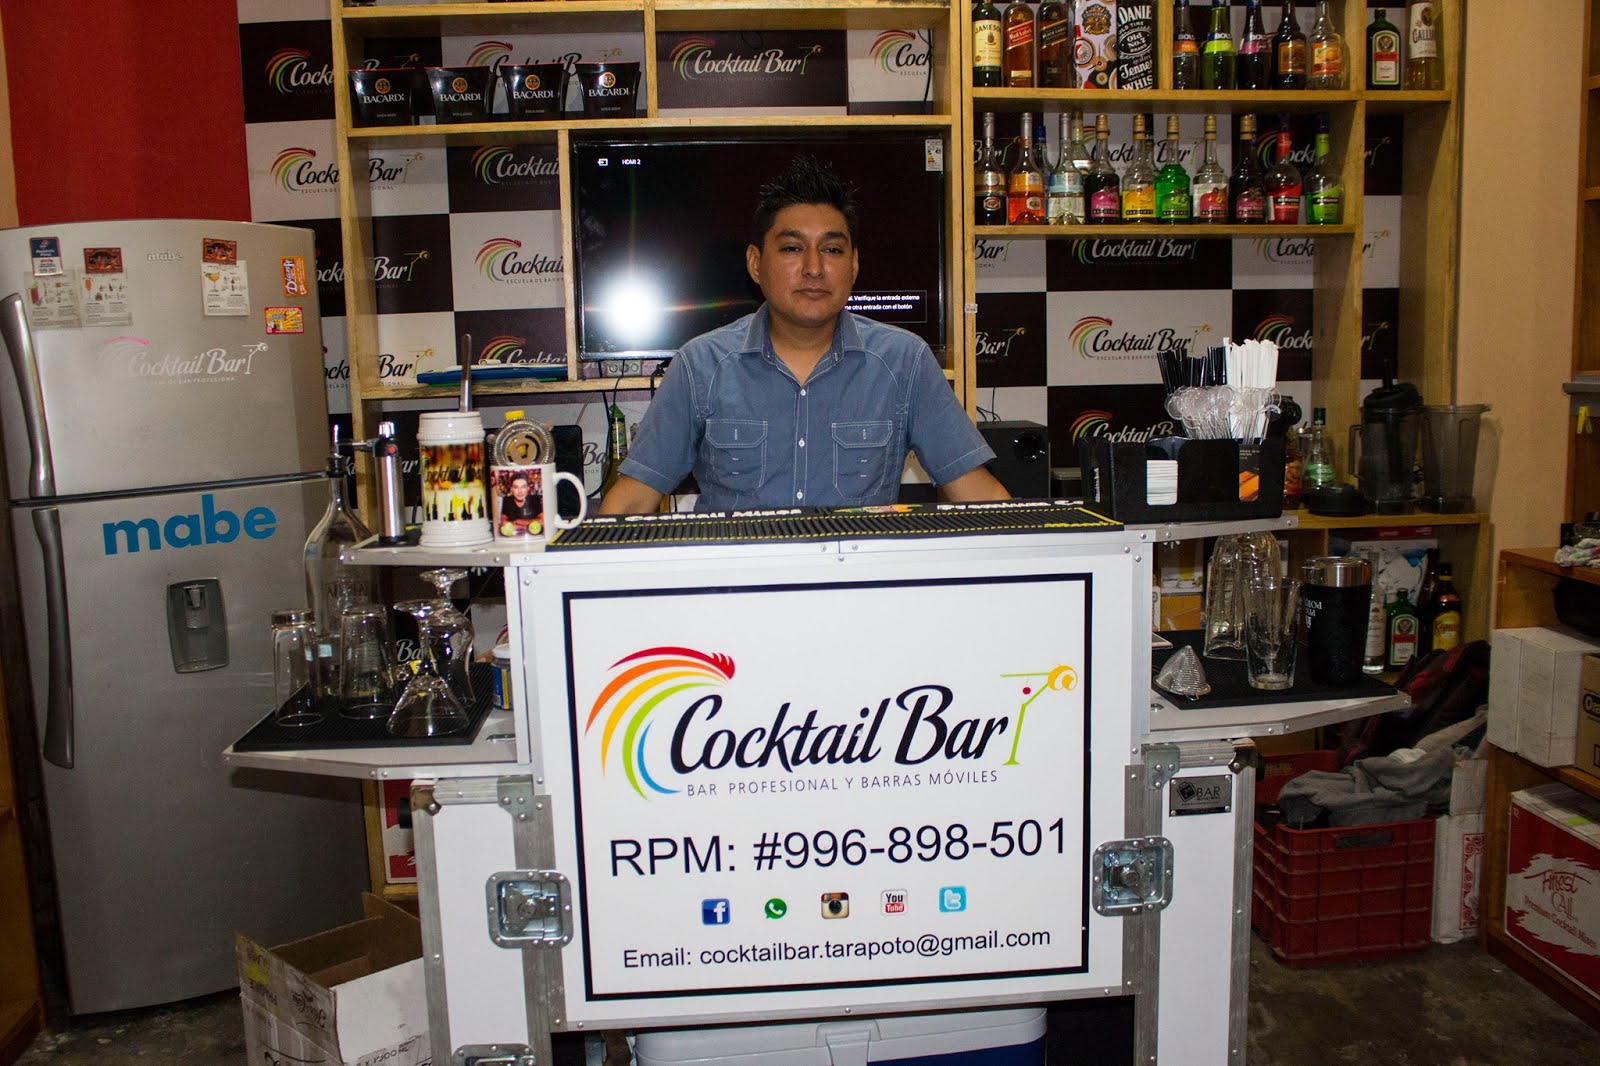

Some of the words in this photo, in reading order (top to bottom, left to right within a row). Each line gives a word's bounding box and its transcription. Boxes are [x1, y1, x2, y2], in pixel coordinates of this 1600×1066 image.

[1118, 5, 1152, 24] DANIE
[1127, 32, 1143, 42] Old
[694, 49, 765, 75] Cocktail
[764, 49, 801, 73] Bar
[1119, 60, 1152, 78] Tenne
[513, 90, 555, 99] BACARDI
[588, 88, 630, 97] BACARDI
[1122, 75, 1153, 90] WHIS
[440, 93, 482, 102] BACARDI
[369, 158, 403, 182] Bar
[147, 250, 183, 261] mabe
[1092, 239, 1157, 258] Cocktail
[1157, 239, 1192, 257] Bar
[374, 256, 408, 281] Bar
[976, 331, 1006, 356] Bar
[1093, 330, 1156, 353] Cocktail
[1157, 328, 1192, 352] Bar
[128, 352, 205, 376] Cocktail
[207, 348, 246, 374] Bar
[380, 354, 412, 378] Bar
[102, 494, 277, 555] mabe
[670, 694, 890, 774] Cocktail
[894, 684, 1008, 765] Bar
[687, 783, 717, 797] BAR
[729, 778, 839, 794] PROFESIONAL
[845, 776, 854, 790] Y
[861, 774, 922, 789] BARRAS
[929, 767, 998, 785] MÓVILES
[1197, 786, 1221, 798] BAR
[611, 835, 736, 877] RPM:
[753, 817, 1066, 871] #996-898-501
[1542, 869, 1578, 894] Finest
[886, 893, 904, 903] You
[886, 904, 904, 913] Tube
[1552, 913, 1577, 937] Cocktail
[624, 947, 692, 968] Email:
[700, 929, 1051, 965] cocktailbar.tarapoto@gmail.com
